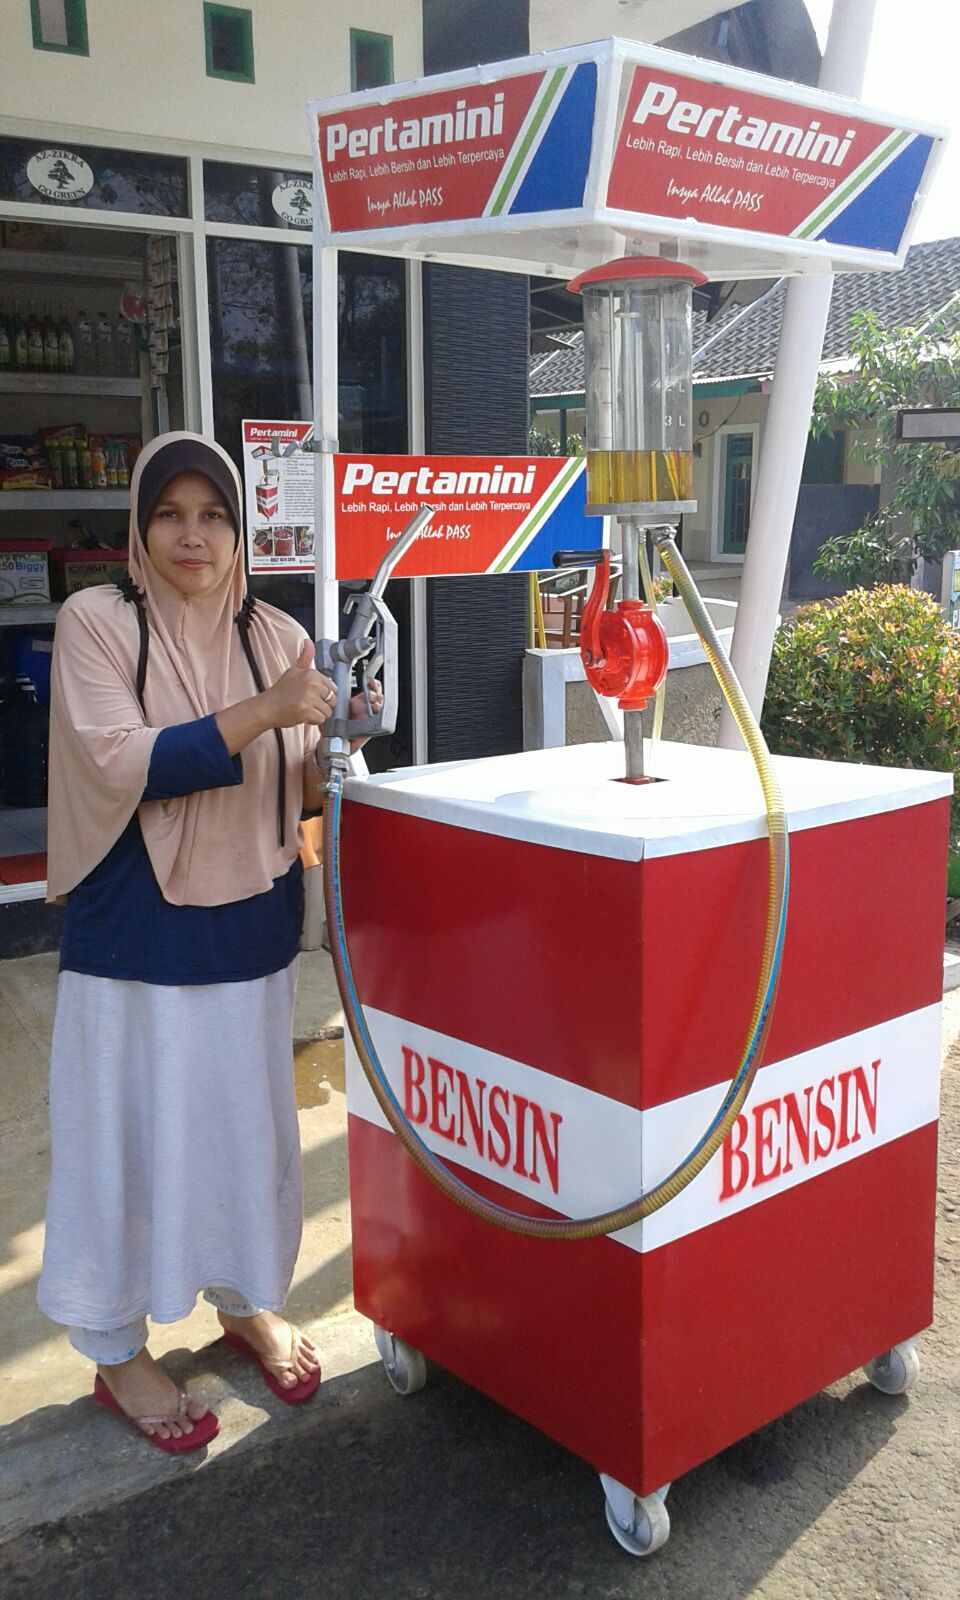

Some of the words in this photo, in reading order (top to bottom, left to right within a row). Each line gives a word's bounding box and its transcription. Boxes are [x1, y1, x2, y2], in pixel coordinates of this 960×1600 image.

[326, 92, 506, 162] Pertamini
[632, 81, 856, 168] Pertamini
[35, 150, 85, 168] AZ-ZIKRA
[329, 169, 349, 183] Lebih
[369, 162, 390, 177] Lebih
[390, 159, 415, 174] Bersih
[416, 158, 432, 170] dan
[433, 152, 456, 168] Lebih
[457, 147, 505, 166] Terpercaya
[626, 133, 656, 151] Lebih
[686, 146, 713, 163] Lebih
[714, 152, 745, 169] Bersih
[746, 160, 763, 173] dan
[765, 163, 790, 179] Lebih
[791, 168, 836, 190] Terpercaya
[38, 184, 52, 196] GO
[53, 187, 86, 199] GREEN
[279, 180, 313, 192] AZ-ZIK
[666, 178, 699, 205] Insya
[700, 183, 734, 205] Allah
[733, 190, 764, 212] PASS
[367, 195, 391, 217] Insya
[393, 189, 418, 210] Allah
[418, 186, 444, 208] PASS
[281, 212, 293, 222] GO
[250, 427, 298, 438] Pertamini
[664, 415, 672, 426] 3
[679, 415, 686, 427] L
[341, 463, 537, 495] Pertamini
[341, 501, 367, 513] Lebih
[394, 501, 418, 512] Lebih
[420, 501, 447, 512] rsih
[448, 501, 464, 511] dan
[465, 500, 488, 511] Lebih
[489, 500, 531, 513] Terpercaya
[416, 524, 444, 540] Allah
[445, 524, 472, 540] PASS
[0, 561, 14, 571] 50
[15, 560, 45, 573] Biggy
[401, 1045, 563, 1195] BENSIN
[719, 1058, 882, 1202] BENSIN
